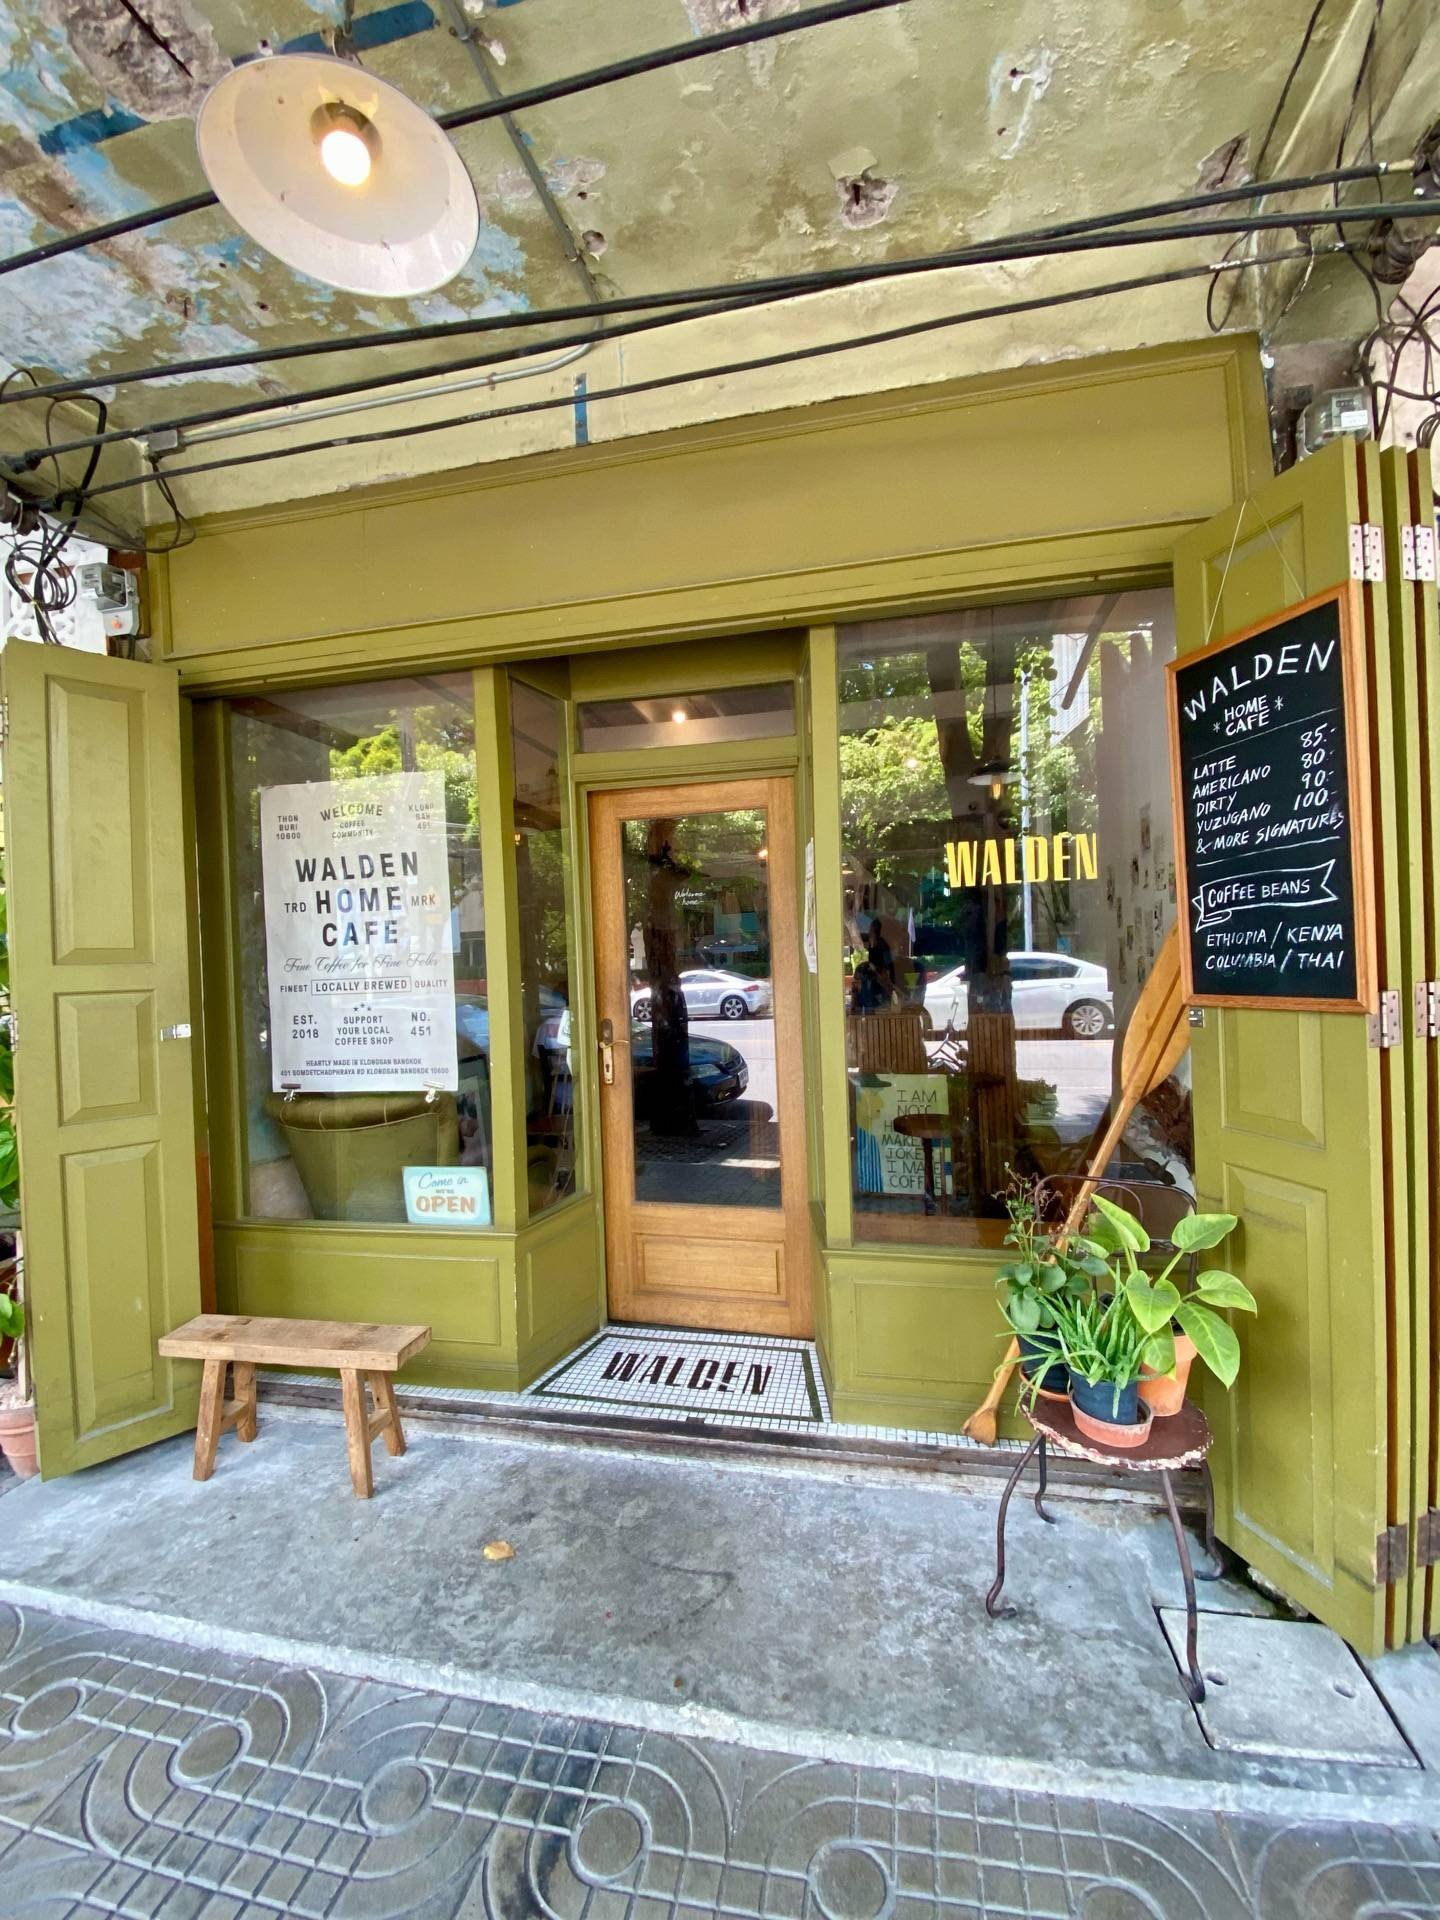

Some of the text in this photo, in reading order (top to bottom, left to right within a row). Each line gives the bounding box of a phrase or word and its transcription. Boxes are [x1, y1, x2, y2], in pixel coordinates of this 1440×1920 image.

[1184, 639, 1335, 721] WALDEN
[1224, 695, 1269, 721] HOME
[1225, 710, 1270, 736] CAFE
[1193, 755, 1237, 780] LATTE
[1192, 765, 1271, 799] AMERICANO
[320, 803, 383, 821] WELCOME
[1196, 791, 1238, 818] DIRTY
[278, 815, 298, 823] THON
[340, 820, 365, 829] COFFEE
[1196, 802, 1271, 835] YUZUGANO
[276, 832, 301, 840] 10600
[331, 829, 373, 838] COMMUNITY
[1196, 808, 1345, 855] & MORE SIGNATURES
[295, 851, 418, 882] WALDEN
[945, 832, 1098, 888] WALDEN
[316, 886, 402, 914] HOME
[411, 894, 436, 906] MRK
[1208, 879, 1311, 907] COFFEE BEANS
[284, 902, 307, 913] TRD
[322, 920, 398, 947] CAFE
[1207, 929, 1267, 947] ETHIOPIA
[1287, 923, 1343, 944] KENYA
[283, 957, 311, 973] Fine
[315, 956, 349, 973] Coffee
[351, 955, 369, 972] for
[373, 954, 402, 968] Fine
[1298, 950, 1344, 969] THAI
[280, 984, 308, 993] FINEST
[316, 980, 407, 992] LOCALLY BREWED
[414, 979, 448, 988] QUALITY
[293, 1015, 317, 1025] EST.
[343, 1015, 383, 1024] SUPPORT
[411, 1012, 431, 1022] NO.
[292, 1029, 319, 1039] 2018
[337, 1026, 390, 1035] YOUR LOCAL
[411, 1026, 431, 1036] 451
[335, 1037, 394, 1046] COFFEE SHOP
[897, 1090, 937, 1102] I AM
[898, 1104, 932, 1116] NOT
[888, 1161, 941, 1175] I MAE
[418, 1172, 470, 1189] Come in
[890, 1175, 942, 1190] COFFE
[416, 1195, 476, 1214] OPEN
[601, 1351, 772, 1395] WALDEN
